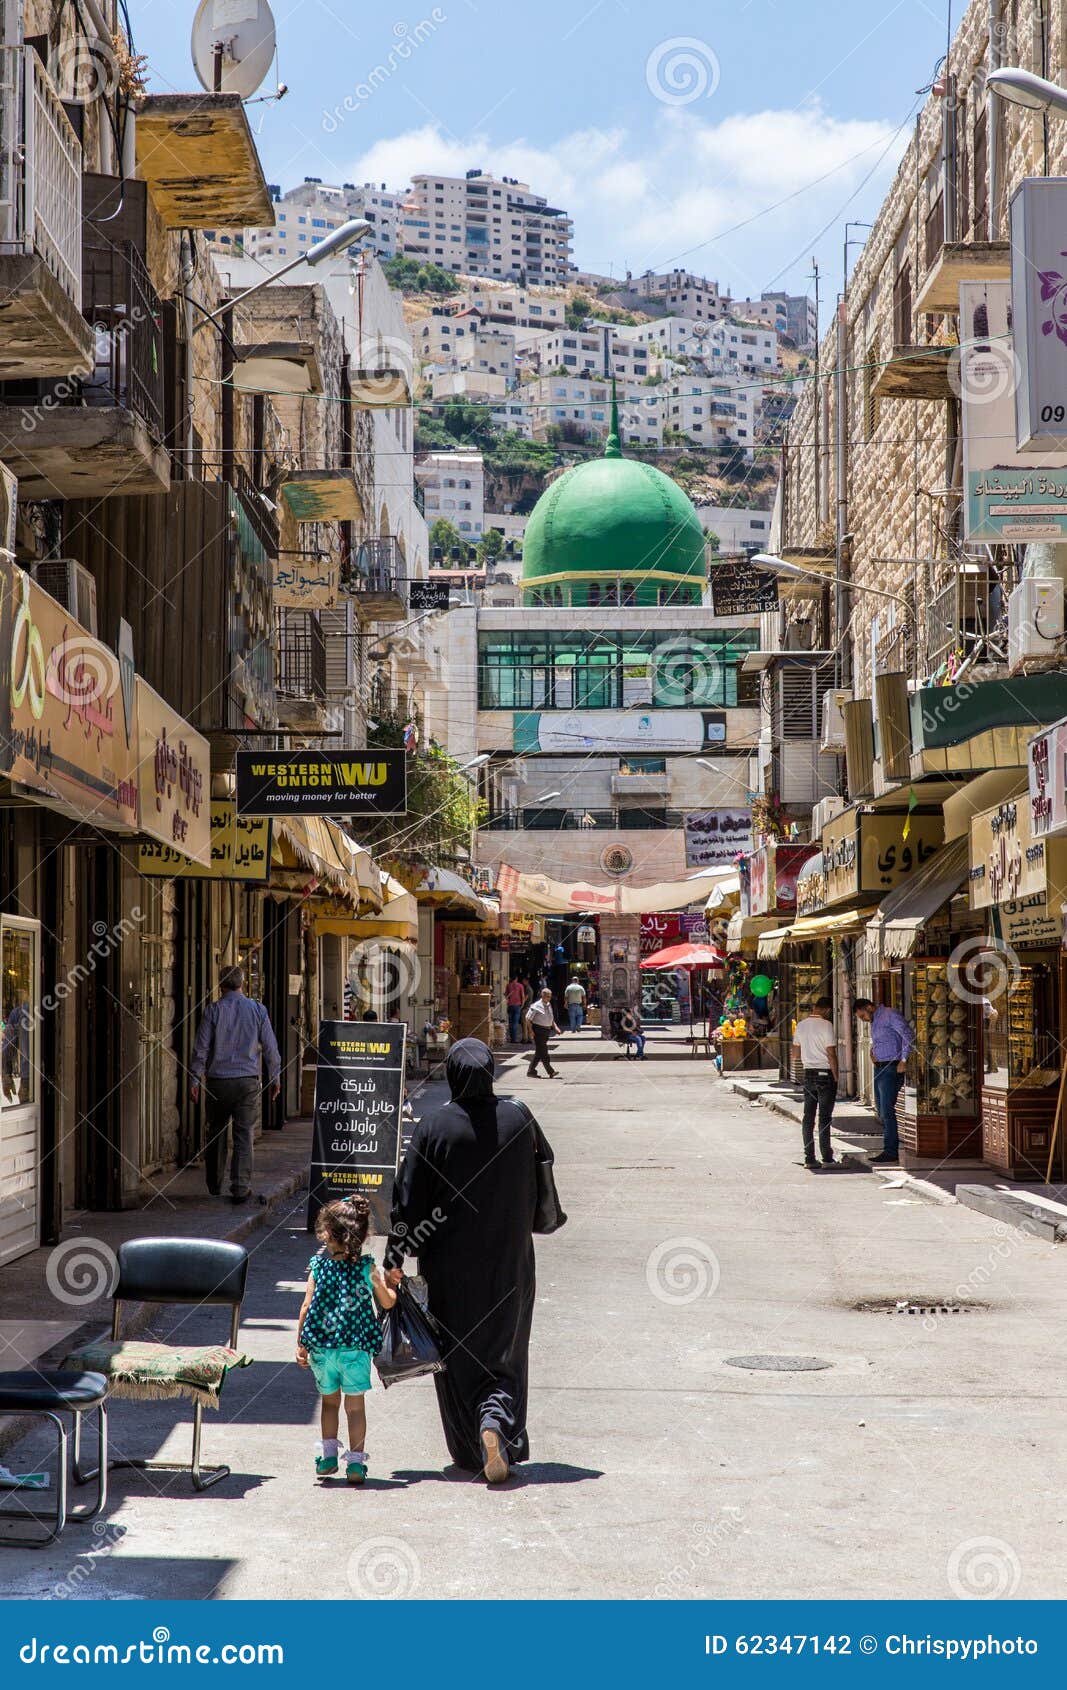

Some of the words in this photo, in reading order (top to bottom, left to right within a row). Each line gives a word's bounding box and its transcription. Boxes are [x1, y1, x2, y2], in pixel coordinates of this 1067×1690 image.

[974, 477, 1034, 500] البيضاء
[251, 764, 332, 776] WESTERN
[277, 775, 332, 787] UNION
[266, 792, 300, 802] moving
[302, 792, 333, 802] money
[334, 791, 347, 800] for
[349, 791, 377, 801] better
[235, 843, 265, 867] طايل
[369, 1042, 391, 1054] WU
[340, 1077, 376, 1094] شركة
[319, 1098, 364, 1114] الحواري
[366, 1099, 395, 1115] طايل
[335, 1116, 376, 1135] وأولاده
[331, 1139, 378, 1155] للصرافة
[360, 1173, 383, 1185] WU
